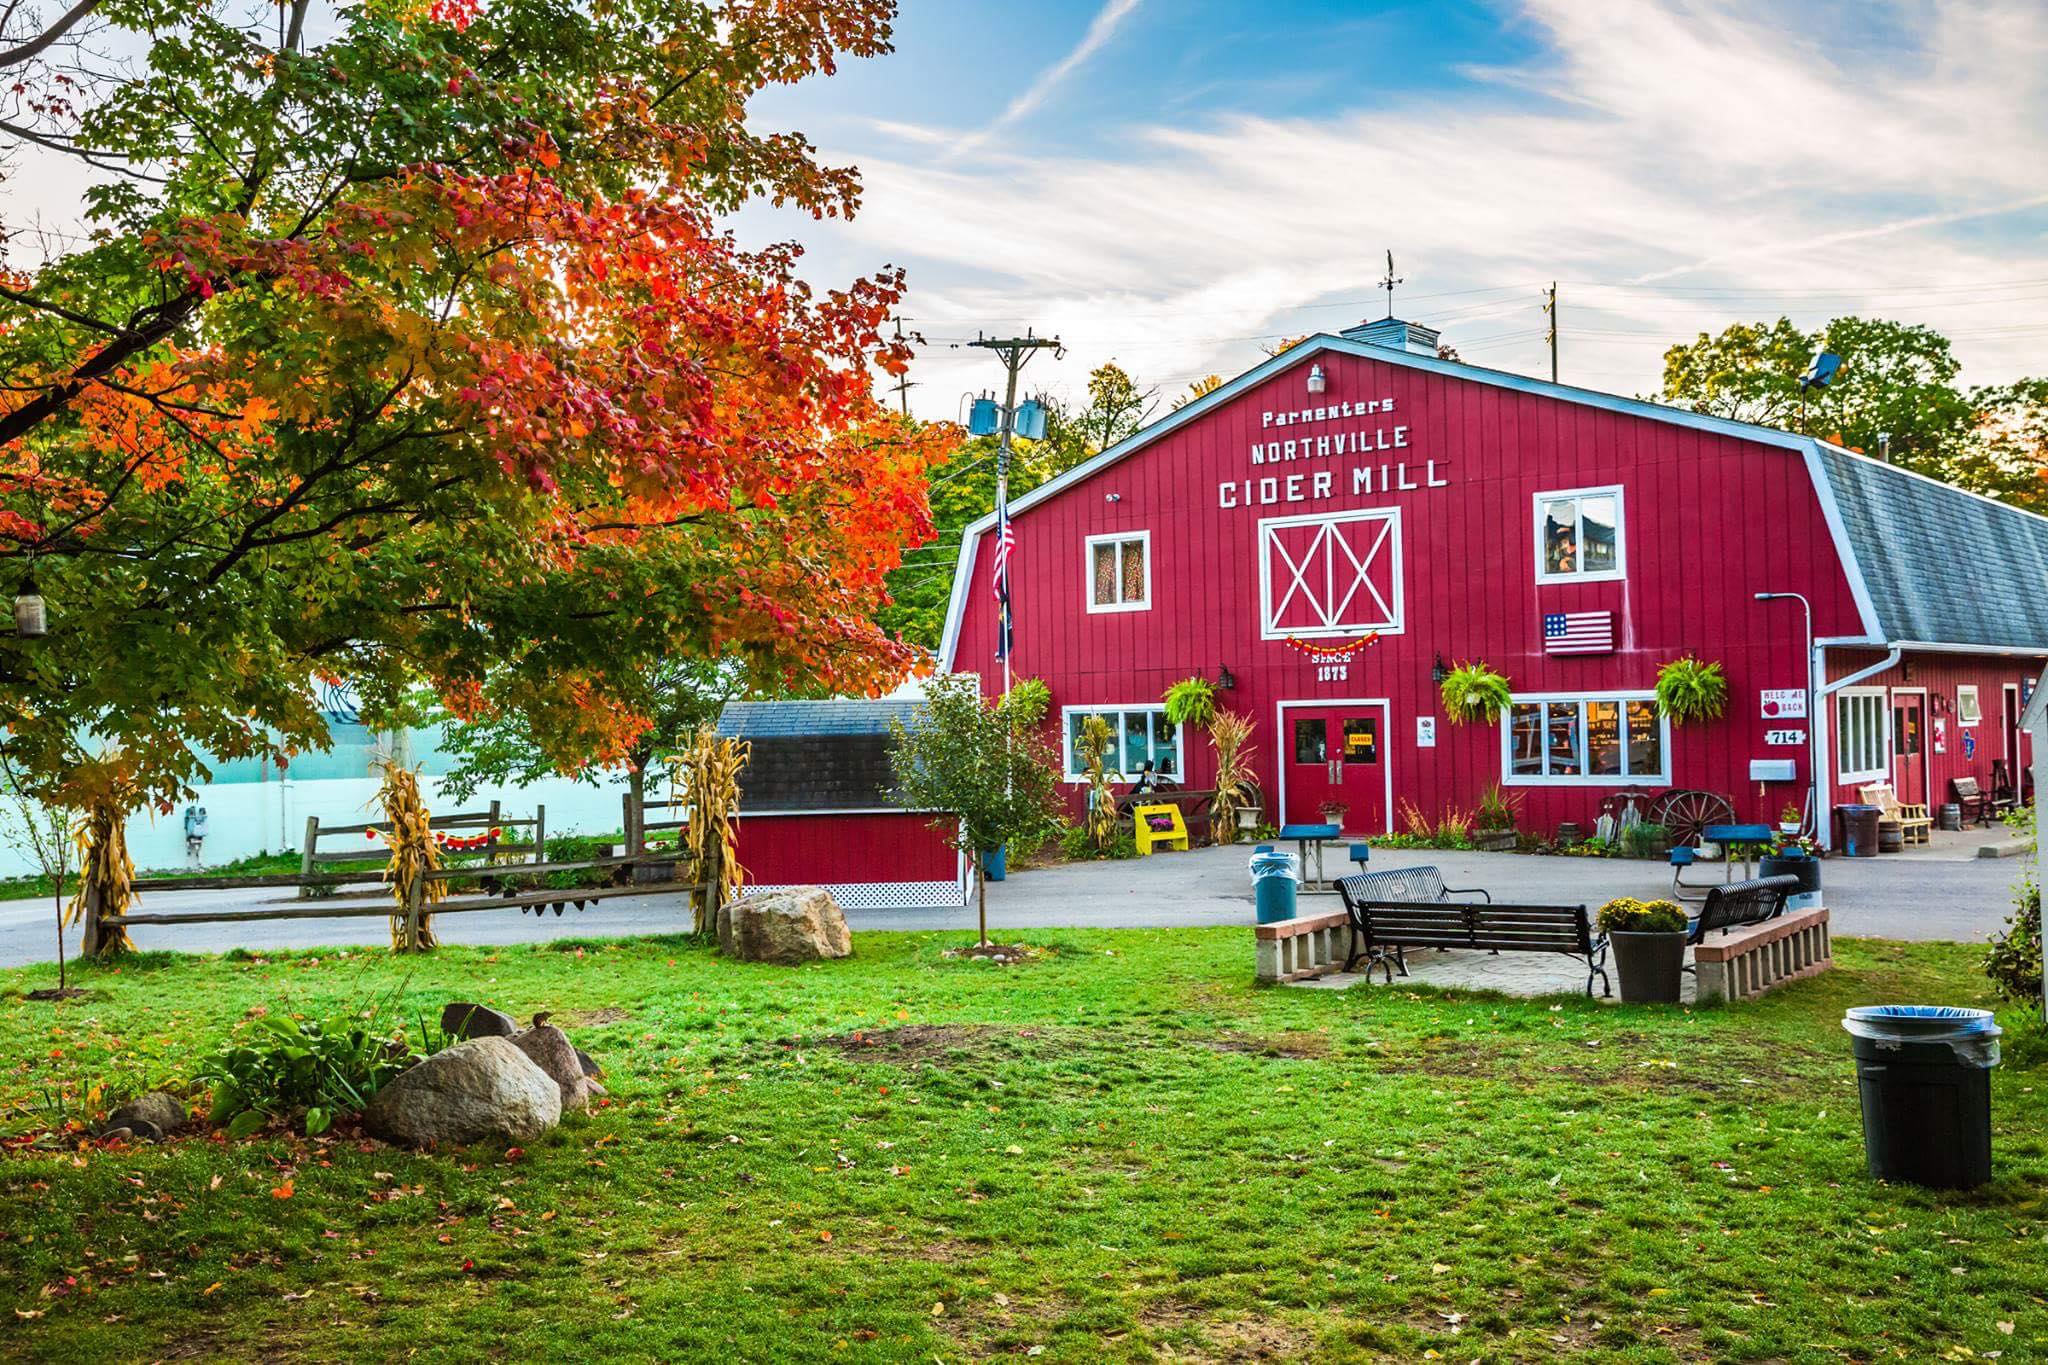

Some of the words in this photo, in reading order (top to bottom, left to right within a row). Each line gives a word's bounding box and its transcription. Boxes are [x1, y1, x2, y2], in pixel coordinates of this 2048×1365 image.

[1251, 426, 1408, 464] NORTHVILLE
[1219, 471, 1332, 508] CIDER
[1353, 460, 1448, 495] MILL
[1772, 732, 1797, 743] 714
